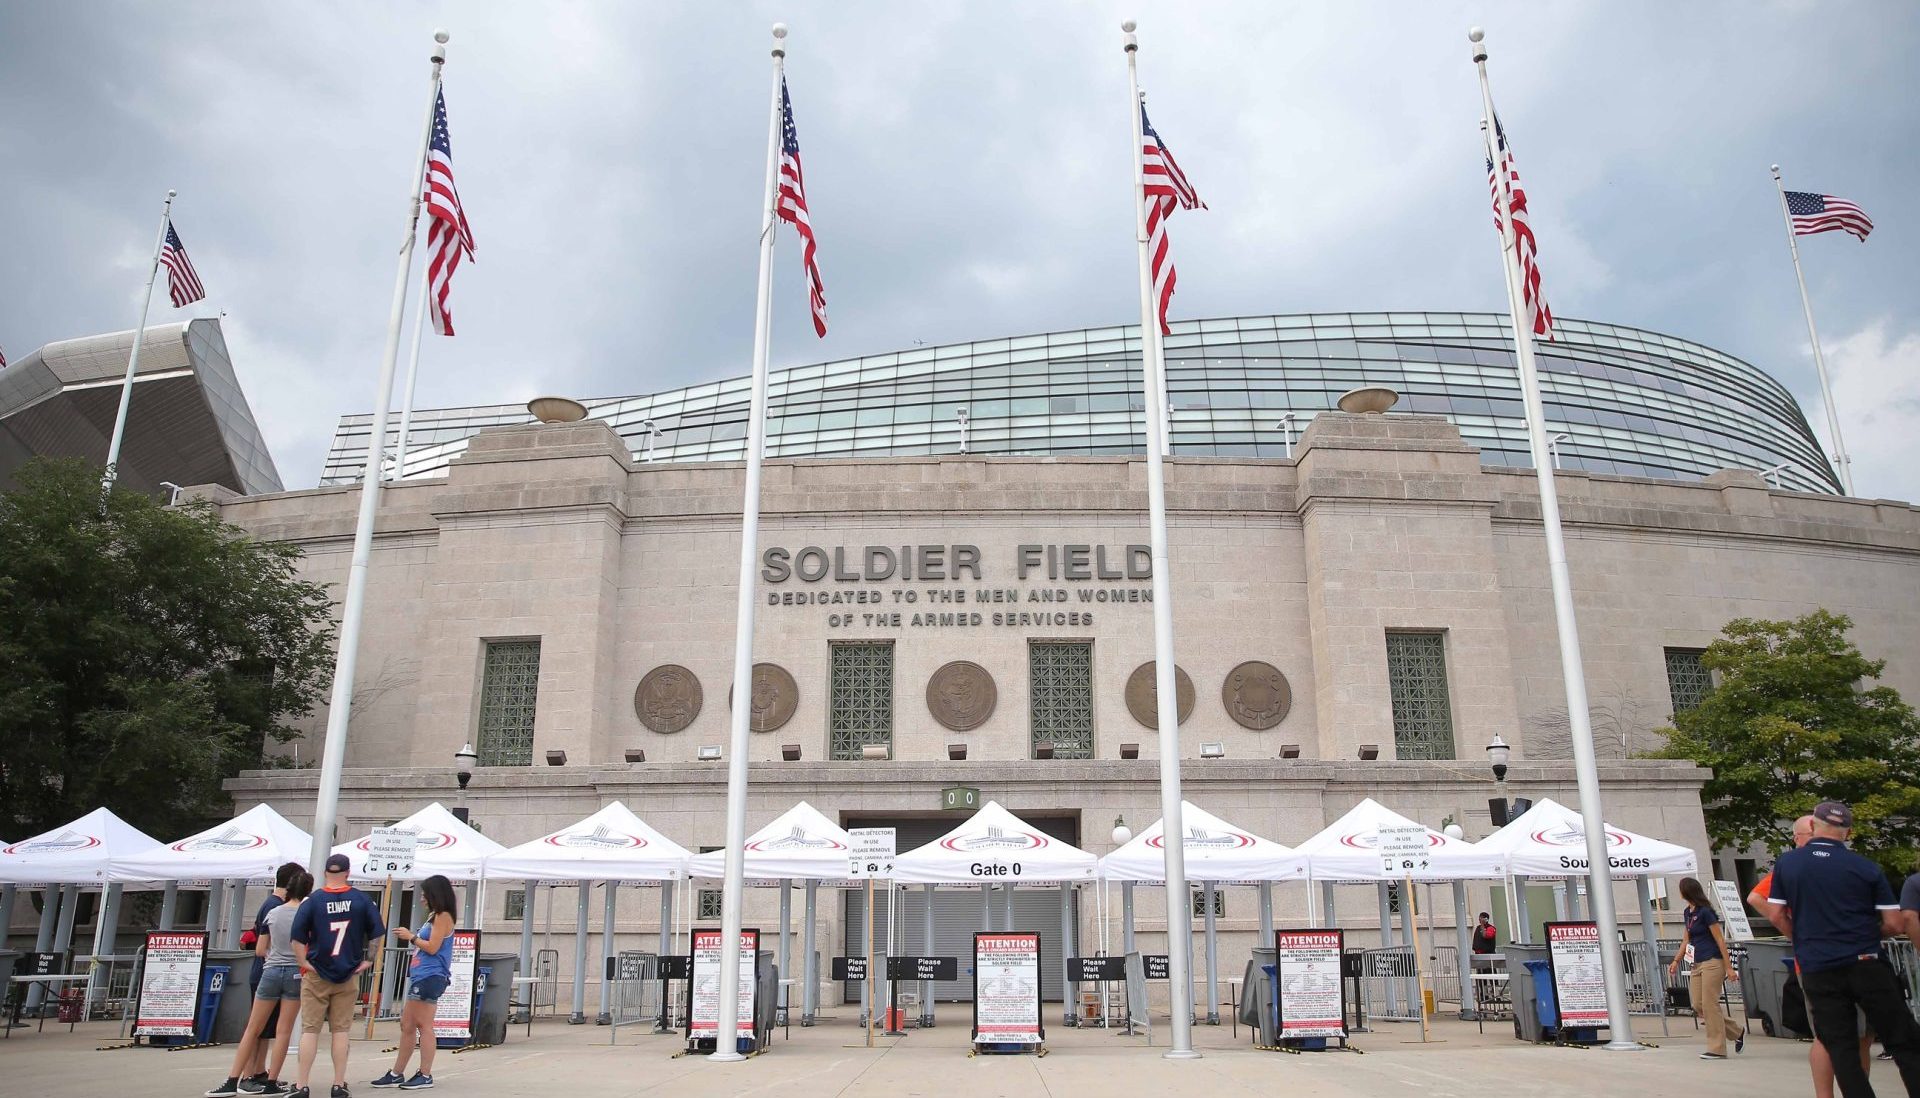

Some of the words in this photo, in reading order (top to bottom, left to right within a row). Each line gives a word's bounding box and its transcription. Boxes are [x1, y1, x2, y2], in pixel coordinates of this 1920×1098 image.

[761, 545, 981, 582] SOLDIER
[1018, 544, 1153, 580] FIELD
[768, 590, 882, 605] DEDICATED
[892, 590, 917, 603] TO
[927, 589, 965, 603] THE
[976, 589, 1018, 603] MEN
[1028, 589, 1068, 602] AND
[1078, 589, 1153, 602] WOMEN
[828, 614, 853, 627] OF
[863, 613, 901, 627] THE
[911, 613, 983, 626] ARMED
[992, 612, 1093, 626] SERVICES
[948, 792, 955, 804] 0
[966, 792, 973, 804] 0
[1560, 856, 1589, 868] Sou
[1608, 857, 1650, 868] Gates
[971, 863, 1007, 876] Gate
[1013, 863, 1021, 875] 0
[326, 900, 352, 914] ELWAY
[330, 920, 350, 956] 7
[1551, 928, 1597, 936] ATTENTIO
[149, 937, 203, 945] ATTENTION
[1281, 936, 1338, 944] ATTENTION
